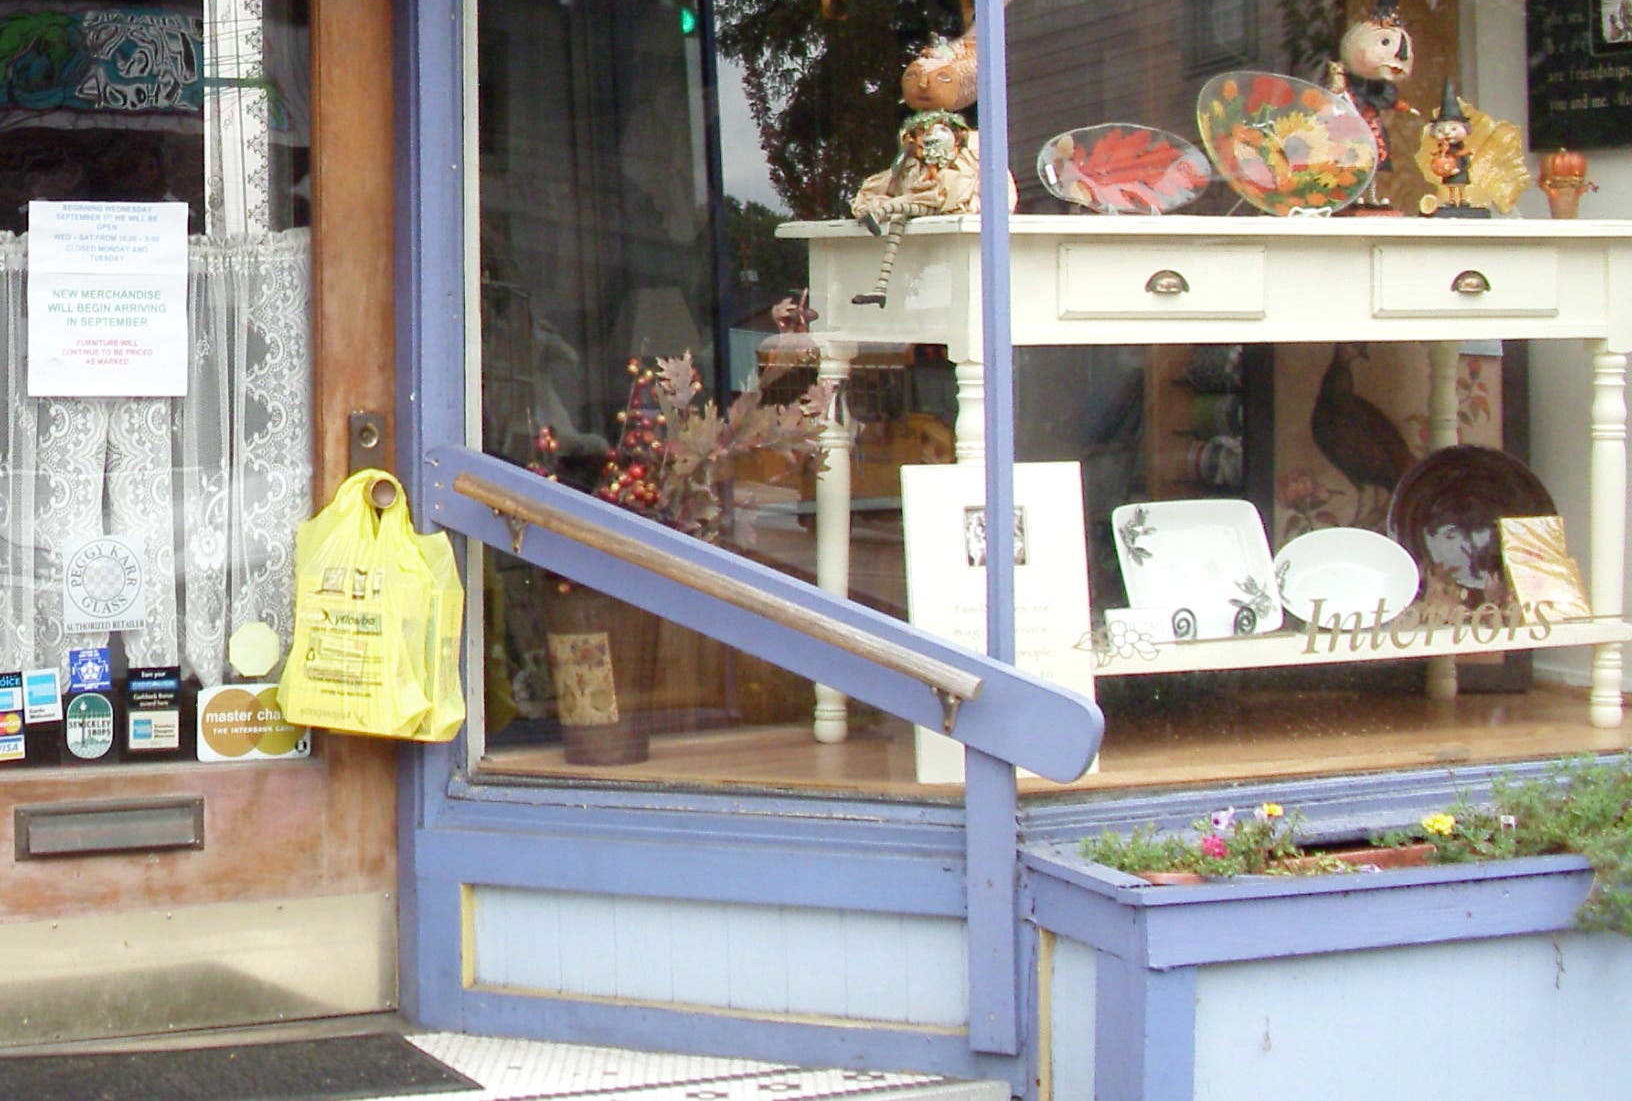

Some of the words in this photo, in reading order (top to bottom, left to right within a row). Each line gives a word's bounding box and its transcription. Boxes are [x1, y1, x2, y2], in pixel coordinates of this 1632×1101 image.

[105, 205, 153, 213] WEDNESDAY
[56, 213, 101, 221] SEPTEMBER
[96, 223, 118, 231] OPEN
[65, 245, 96, 253] CLOSED
[90, 254, 124, 262] TUESDAY
[52, 289, 78, 299] NEW
[81, 289, 161, 300] MERCHANDISE
[48, 303, 74, 313] WILL
[76, 303, 111, 314] BEGIN
[114, 303, 167, 314] ARRIVING
[67, 317, 77, 327] IN
[80, 317, 148, 328] SEPTEMBER
[76, 339, 119, 347] FURNITURE
[120, 339, 138, 347] WILL
[62, 348, 100, 356] CONTINUE
[101, 348, 111, 356] TO
[113, 348, 124, 356] BE
[125, 348, 153, 356] PRICED
[85, 357, 96, 365] AS
[70, 543, 104, 588] PEGGY
[110, 544, 137, 587] KARR
[81, 594, 129, 615] GLASS
[66, 621, 111, 631] AUTHORIZED
[112, 618, 145, 629] RETAILER
[1301, 598, 1554, 656] Interiors
[206, 708, 253, 723] master
[212, 727, 228, 735] THE
[231, 725, 274, 734] INTERBANK
